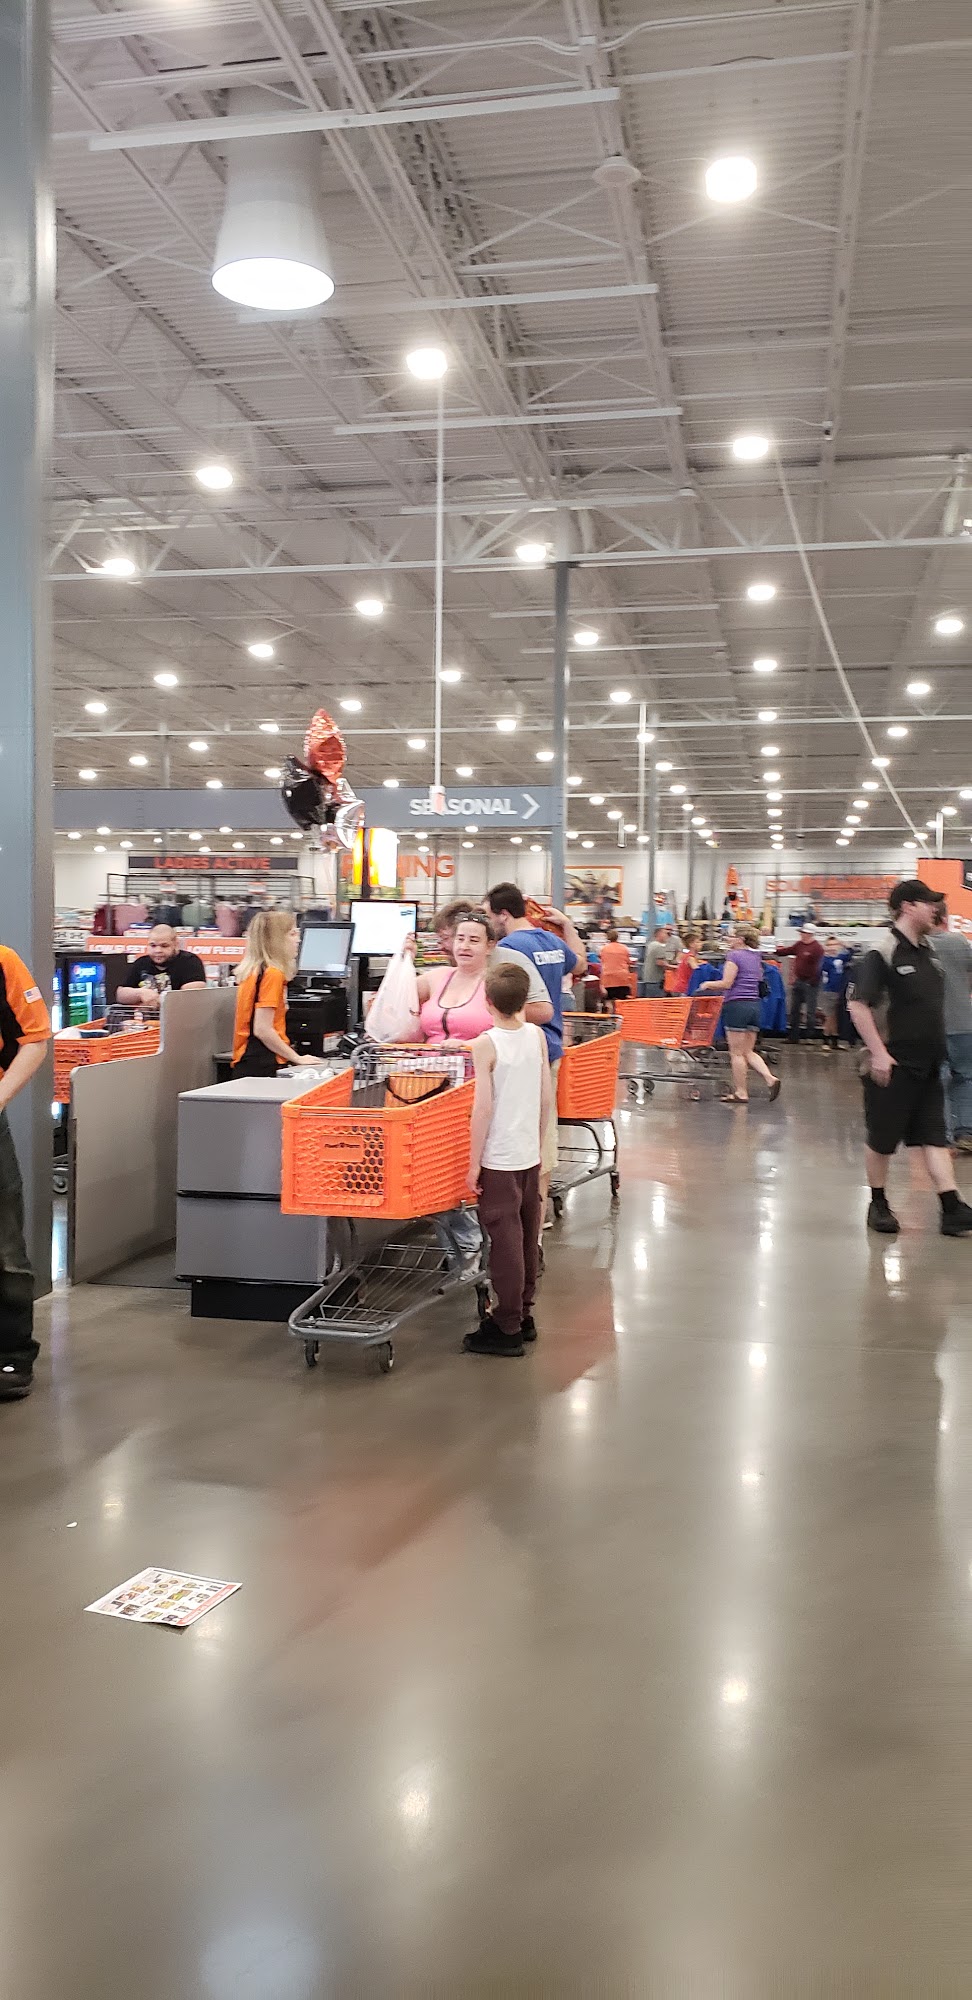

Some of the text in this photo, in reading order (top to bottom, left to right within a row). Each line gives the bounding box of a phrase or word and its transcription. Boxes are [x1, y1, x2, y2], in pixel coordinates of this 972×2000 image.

[410, 798, 518, 815] SEASONAL
[154, 857, 271, 869] LADIES ACTIVE
[187, 945, 246, 955] LOW FLEET
